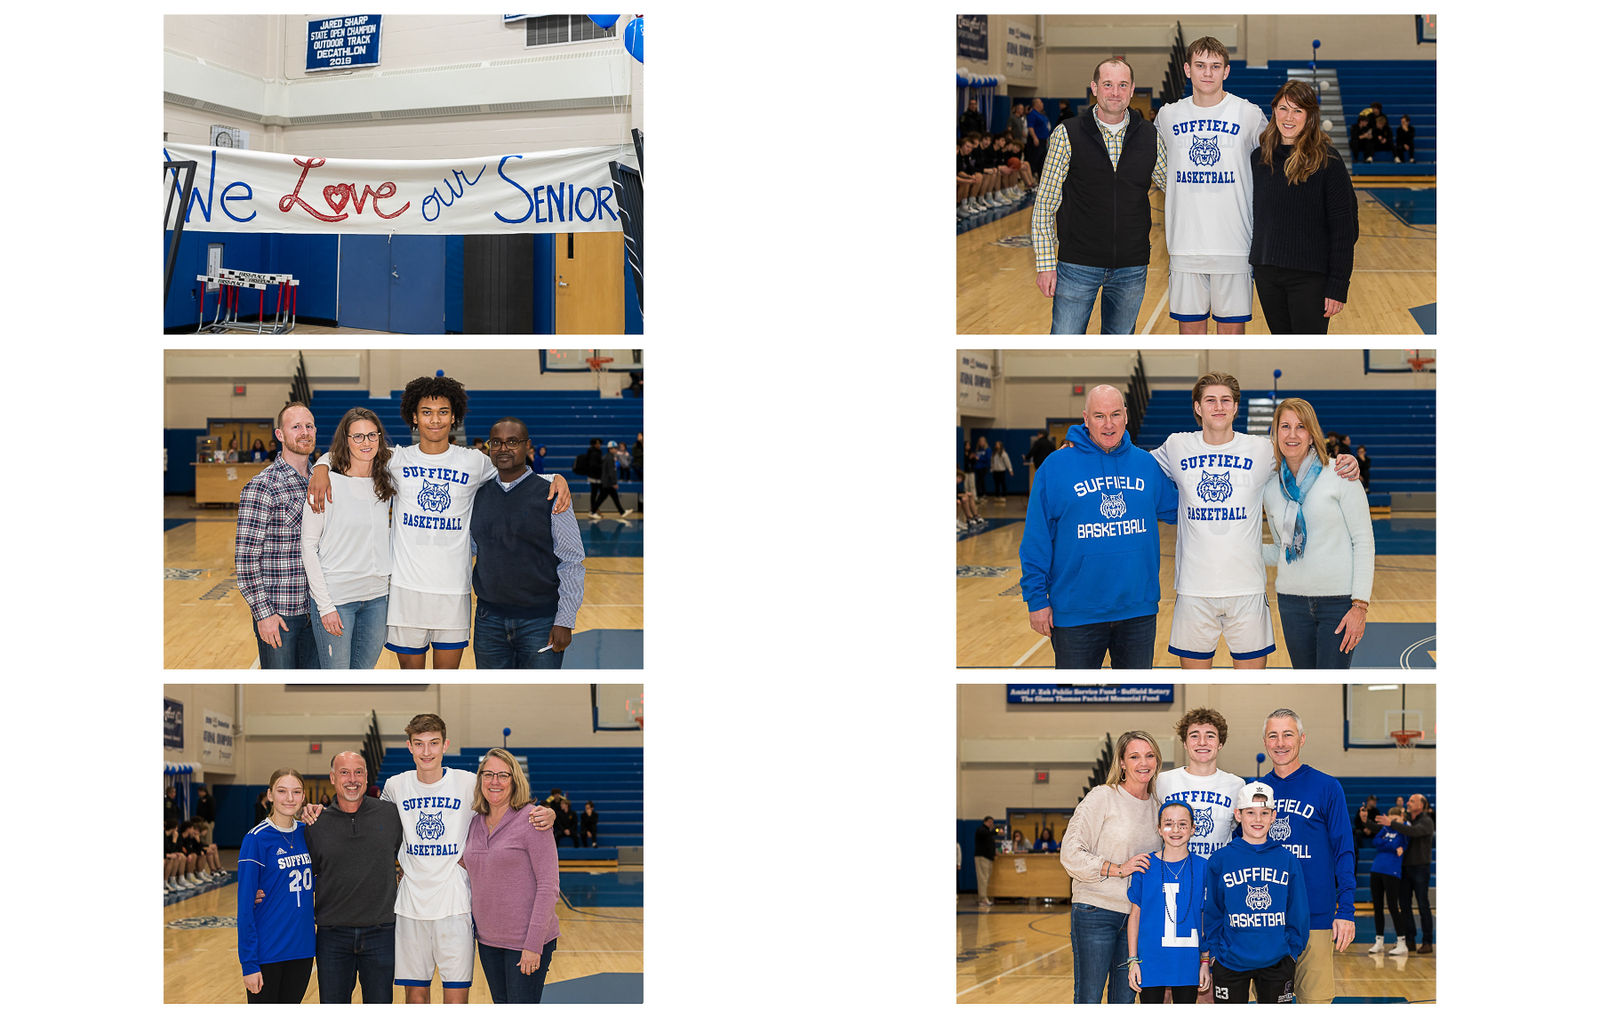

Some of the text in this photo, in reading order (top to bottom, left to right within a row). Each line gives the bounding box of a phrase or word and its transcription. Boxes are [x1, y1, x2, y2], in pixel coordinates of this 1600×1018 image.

[320, 16, 369, 30] JARED SHARP
[310, 24, 377, 41] STATE OPEN CHAMPION
[313, 34, 372, 50] OUTDOOR TRACK
[316, 45, 367, 59] DECATHLON
[1172, 119, 1241, 136] SUFFIELD
[163, 147, 257, 223] We
[421, 164, 487, 222] our
[1176, 170, 1236, 184] BASKETBALL
[1180, 453, 1254, 471] SUFFIELD
[402, 466, 470, 485] SUFFIELD
[1073, 476, 1145, 497] SUFFIELD
[403, 512, 462, 531] BASKETBALL
[1077, 518, 1148, 539] BASKETBALL
[402, 796, 462, 811] SUFFIELD
[289, 867, 312, 893] 20
[1223, 867, 1289, 888] SUFFIELD
[1161, 882, 1199, 948] L
[1215, 985, 1229, 1000] 23
